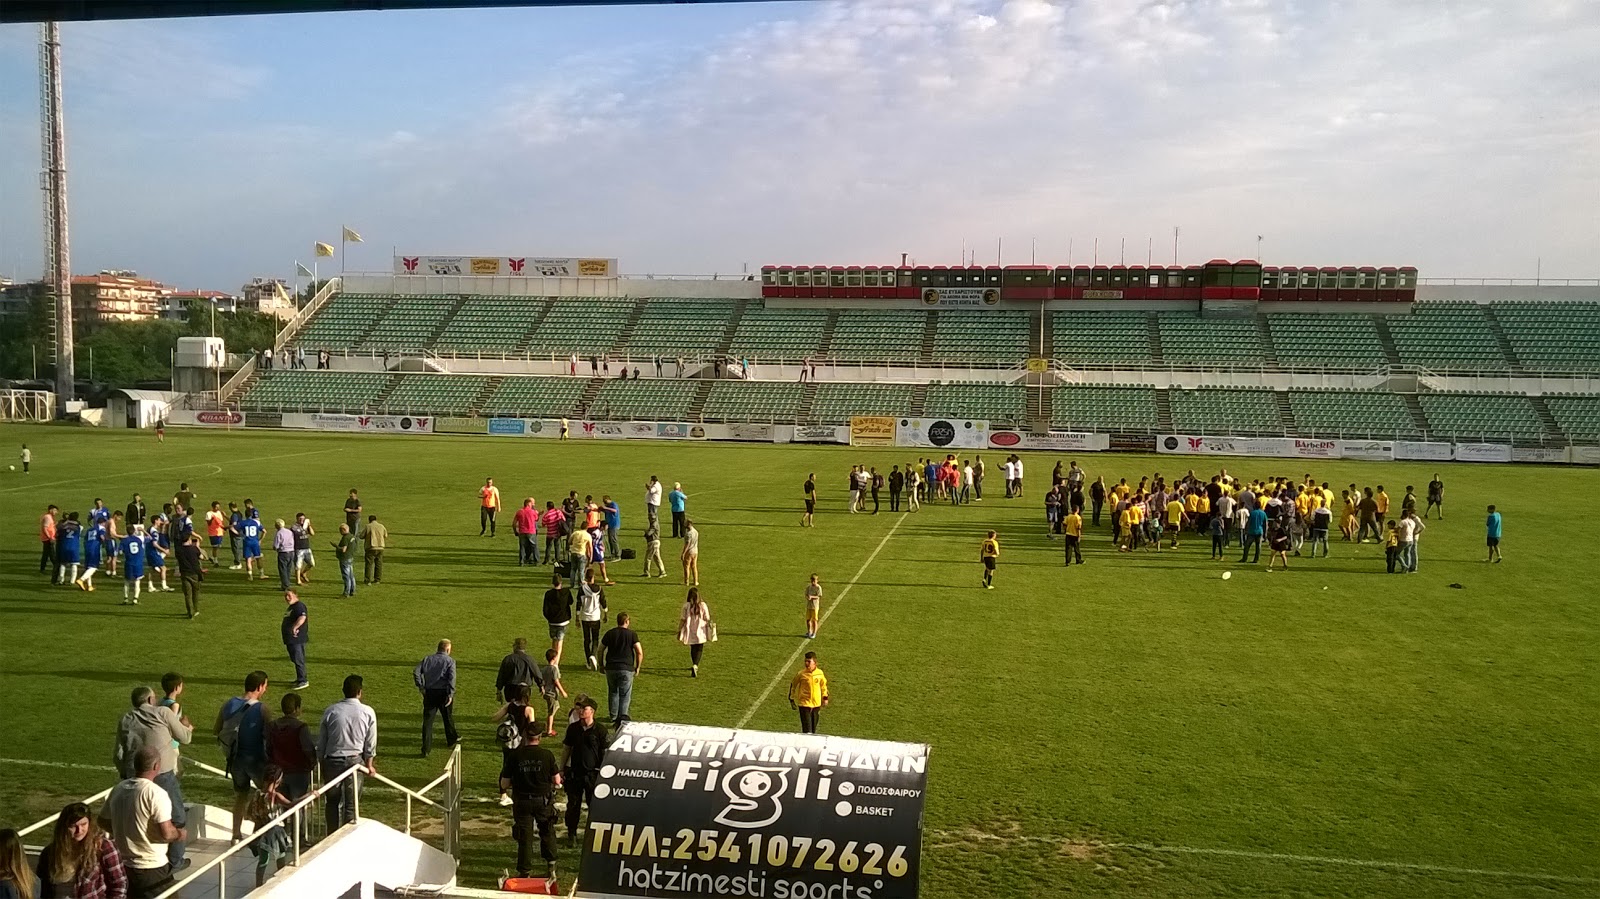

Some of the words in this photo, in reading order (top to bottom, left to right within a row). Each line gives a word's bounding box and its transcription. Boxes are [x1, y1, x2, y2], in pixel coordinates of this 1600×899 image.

[436, 418, 467, 426] COSMO
[468, 419, 486, 427] PRO
[244, 526, 257, 537] 18
[129, 542, 139, 555] 6
[608, 734, 809, 765] ΑΘΛΗΤΙΚΩΝ
[818, 748, 927, 774] ΕΙΔΩΝ
[616, 768, 667, 780] HANDBALL
[612, 788, 650, 799] VOLLEY
[855, 786, 922, 799] ΠΟΔΟΣΦΑΙΡΟΥ
[855, 805, 895, 818] BASKET
[617, 860, 767, 898] hatzimesti
